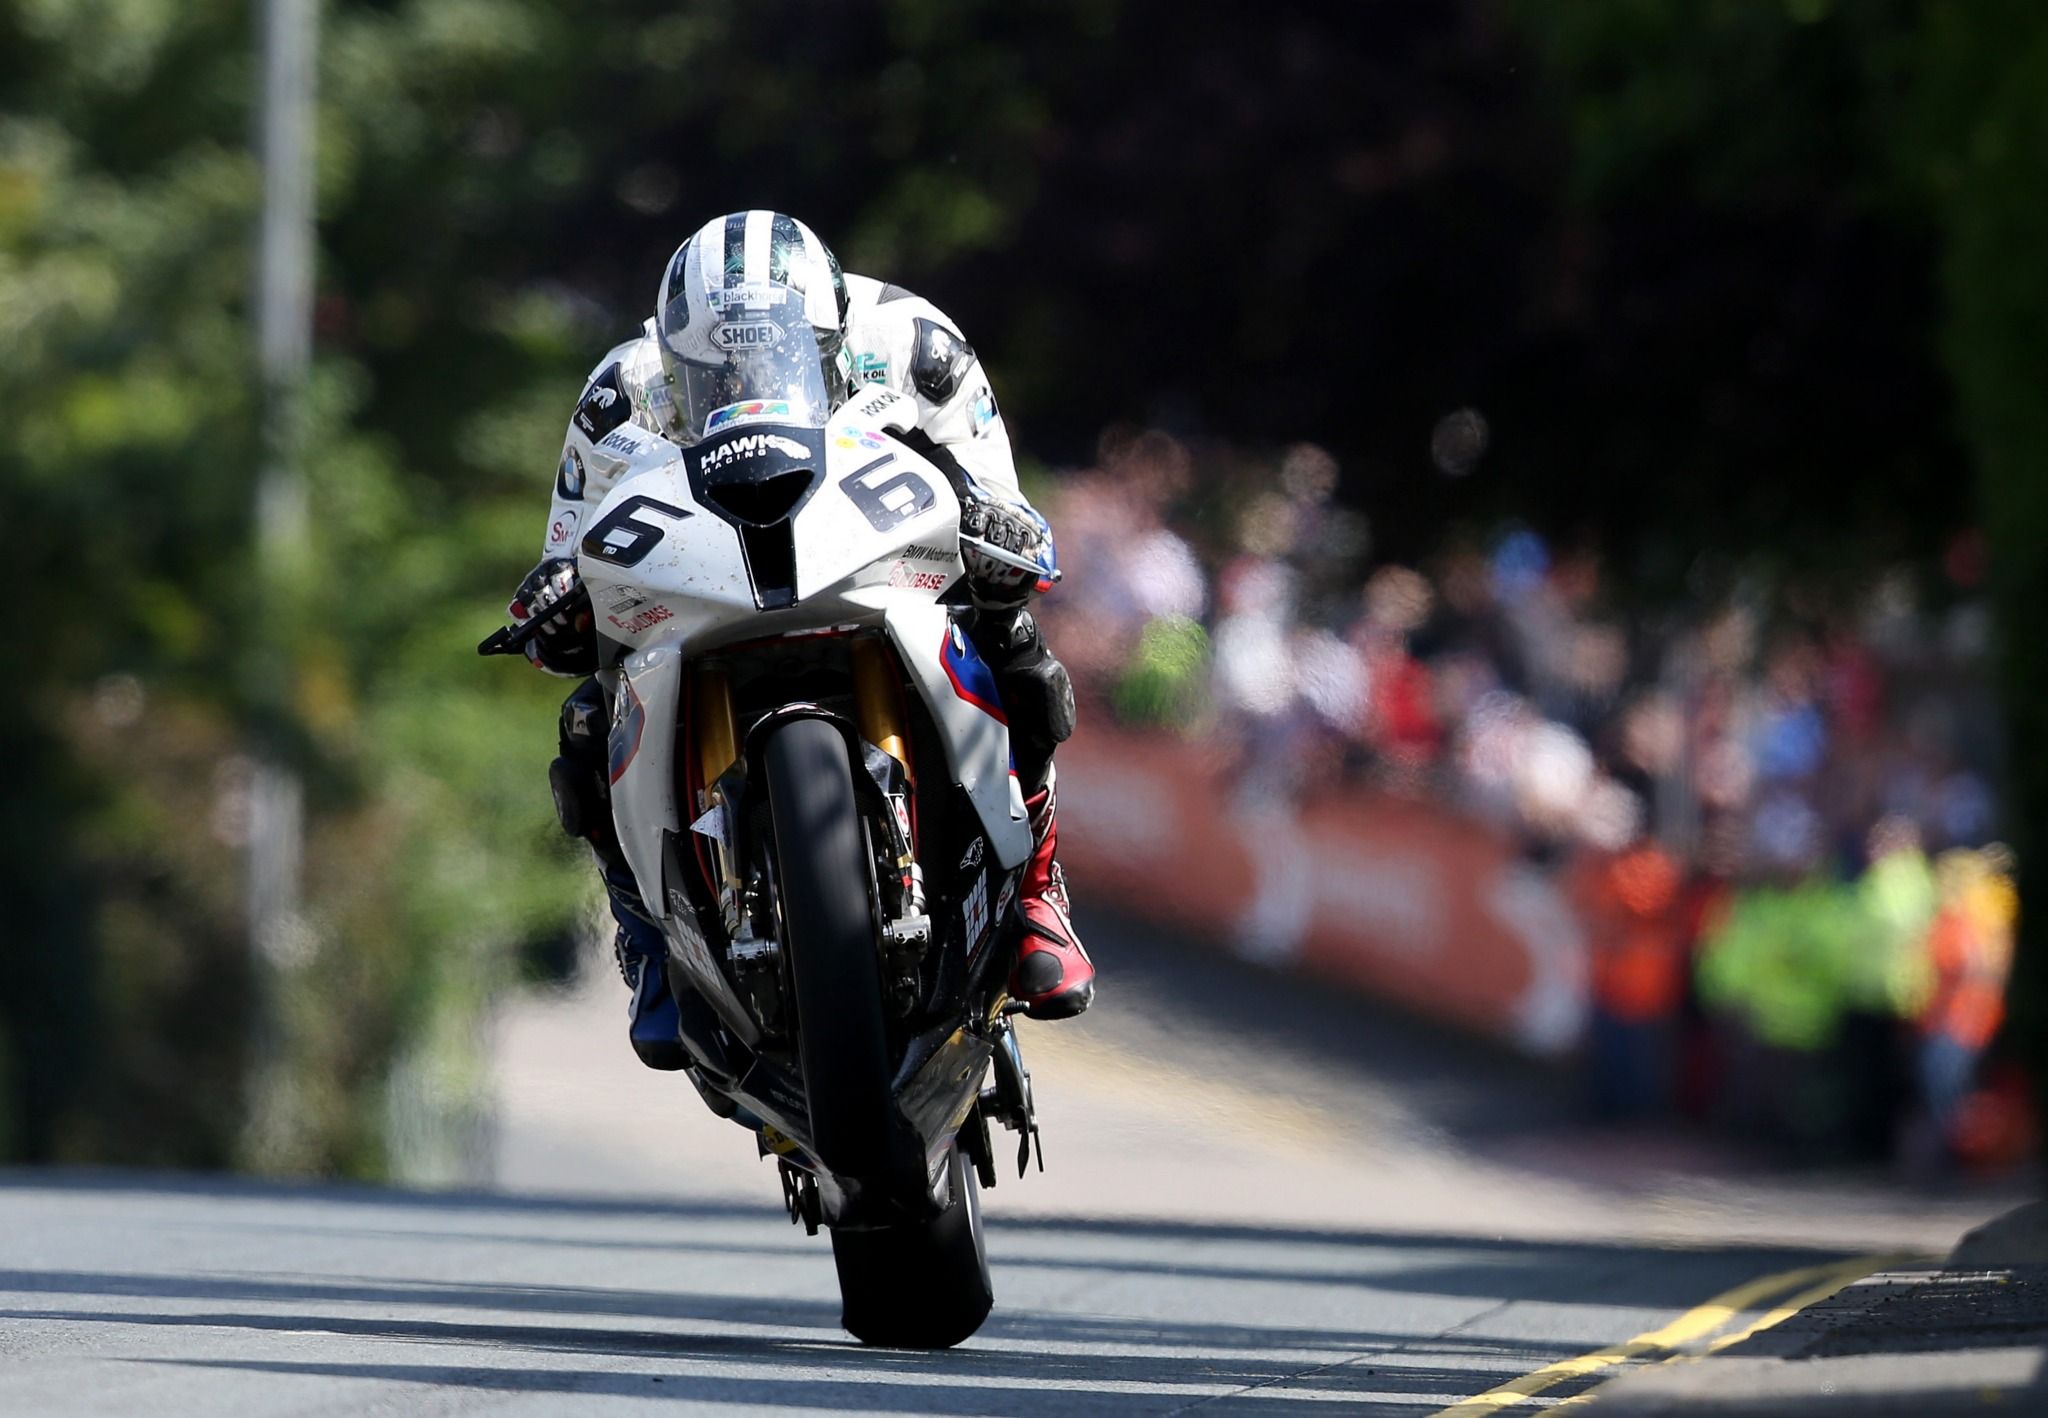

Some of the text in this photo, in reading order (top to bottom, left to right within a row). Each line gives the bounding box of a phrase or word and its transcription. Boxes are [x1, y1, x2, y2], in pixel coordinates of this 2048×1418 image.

[721, 326, 773, 345] SHOEI
[700, 434, 777, 470] HAWK
[704, 448, 768, 476] RACING
[838, 452, 937, 533] 6
[581, 494, 695, 569] 6
